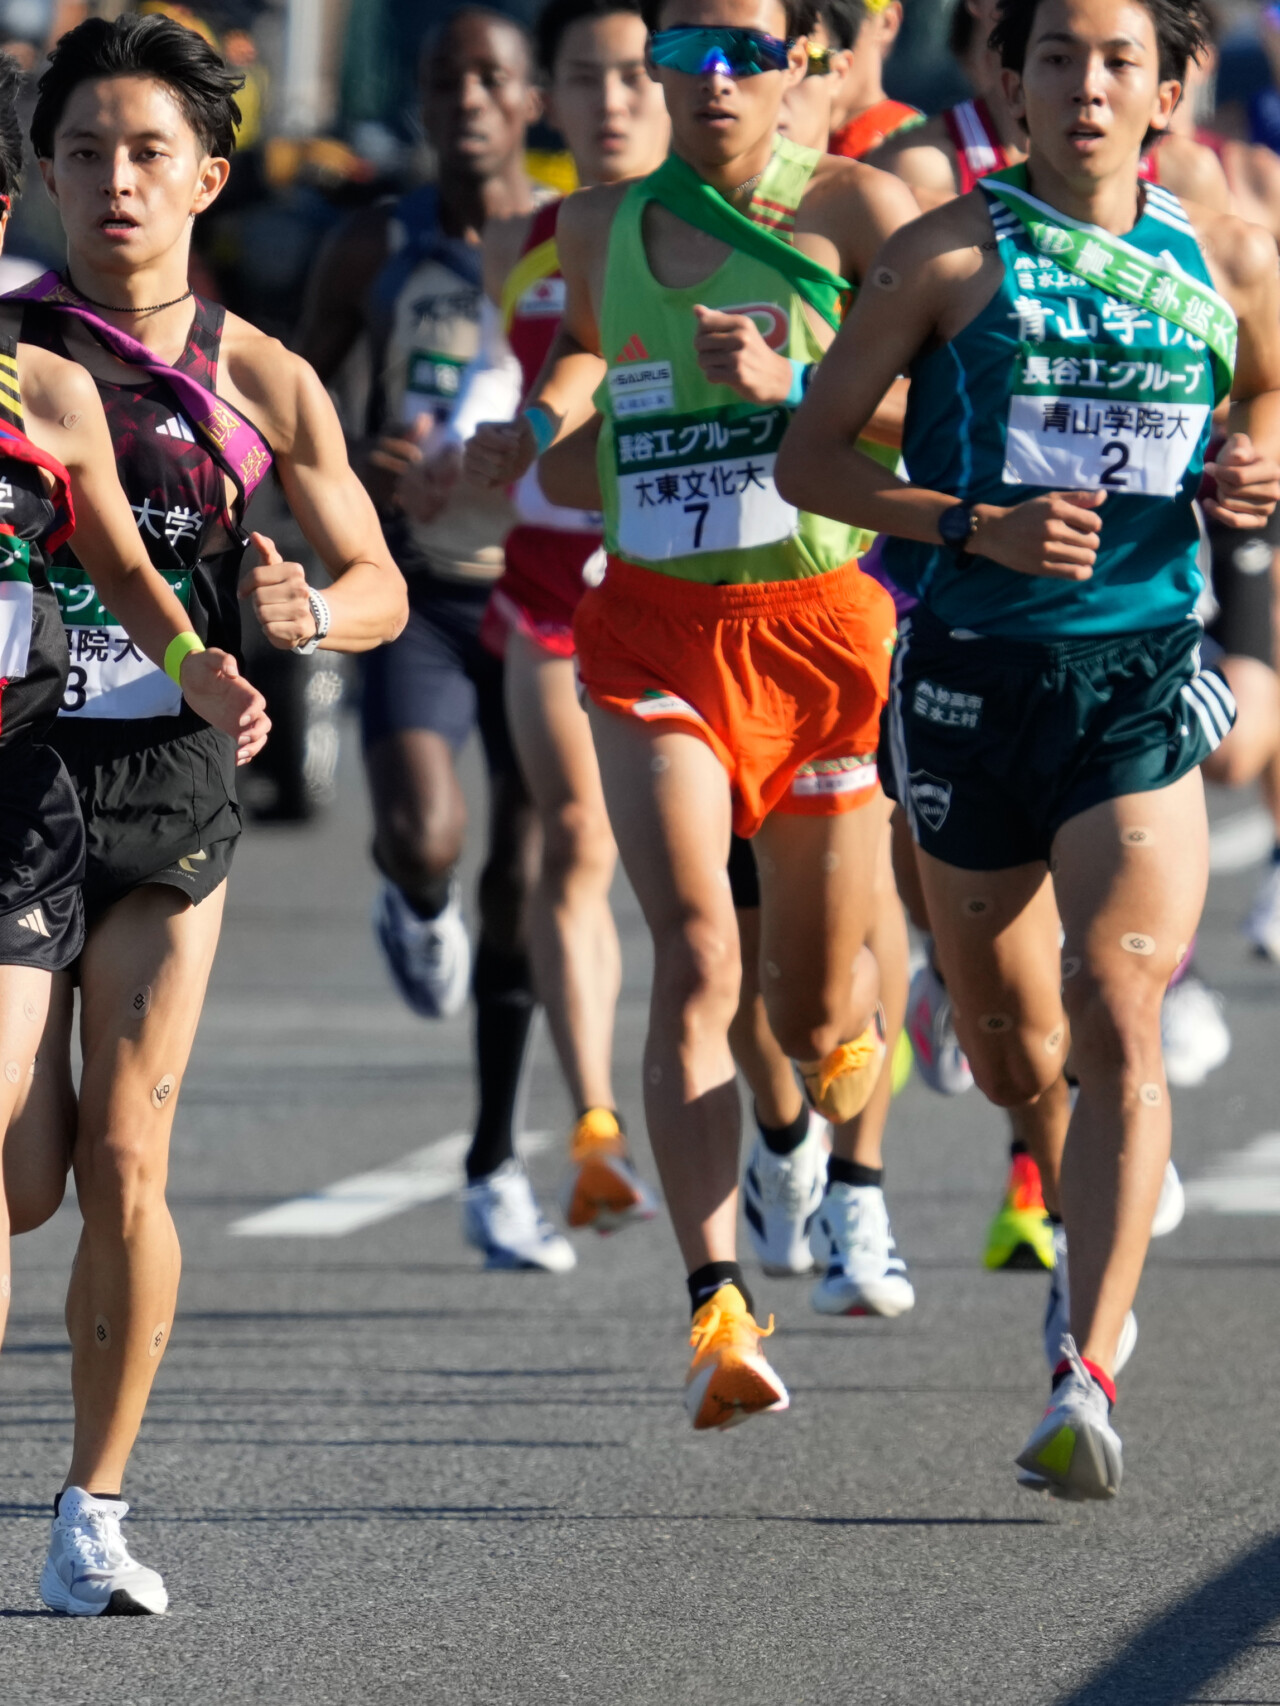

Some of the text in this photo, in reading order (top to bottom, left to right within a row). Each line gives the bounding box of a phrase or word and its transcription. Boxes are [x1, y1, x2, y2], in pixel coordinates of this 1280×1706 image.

[615, 368, 670, 386] SAURUS
[1022, 356, 1205, 394] 長谷工グループ
[618, 409, 780, 464] 長谷工グループ
[1042, 401, 1191, 441] 青山学院大
[634, 460, 767, 509] 大東文化大
[1099, 440, 1130, 487] 2
[131, 497, 203, 547] 大学
[683, 501, 710, 549] 7
[67, 628, 144, 664] 院大
[59, 665, 88, 713] 3
